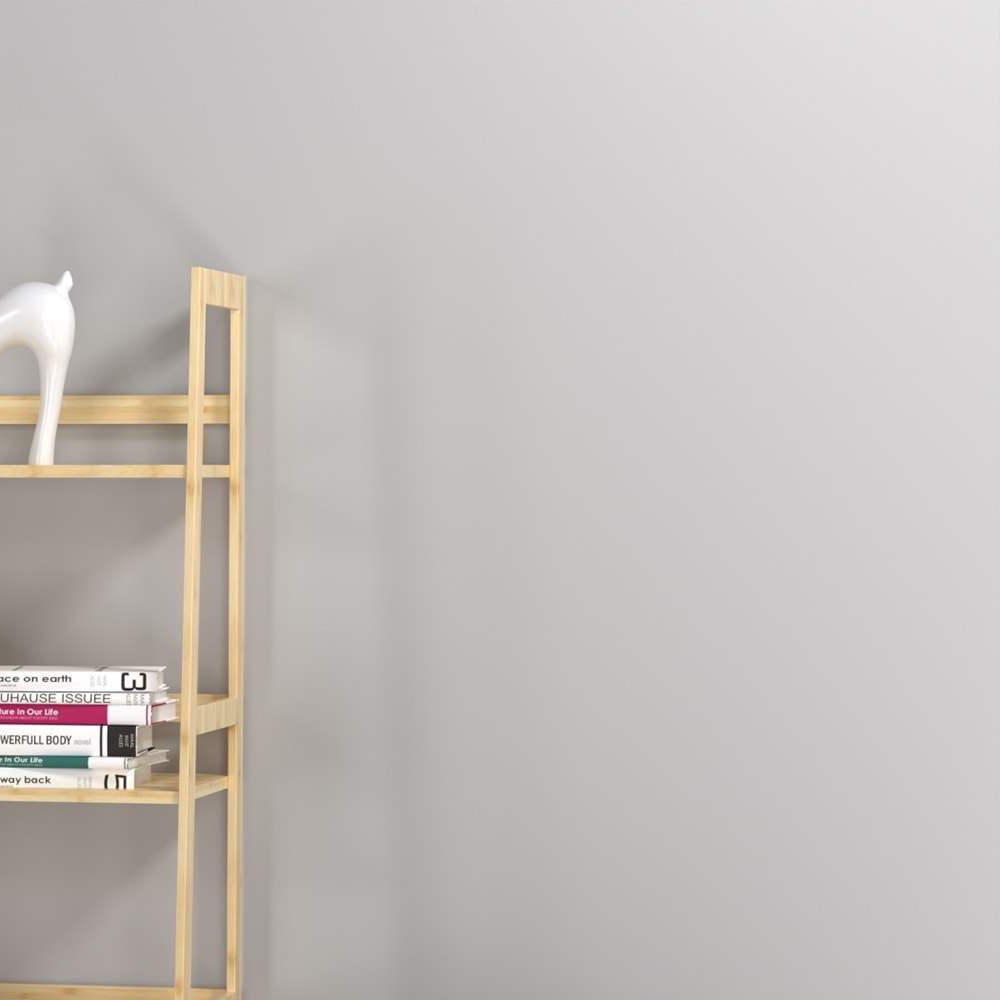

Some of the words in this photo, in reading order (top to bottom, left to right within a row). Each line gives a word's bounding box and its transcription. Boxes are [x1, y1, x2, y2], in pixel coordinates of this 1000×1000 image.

[42, 675, 72, 683] earth
[121, 672, 147, 691] 3
[62, 693, 111, 704] ISSUEE
[26, 708, 42, 716] Our
[44, 708, 59, 716] Life
[46, 735, 72, 745] BODY
[0, 777, 21, 785] way
[24, 776, 51, 784] back
